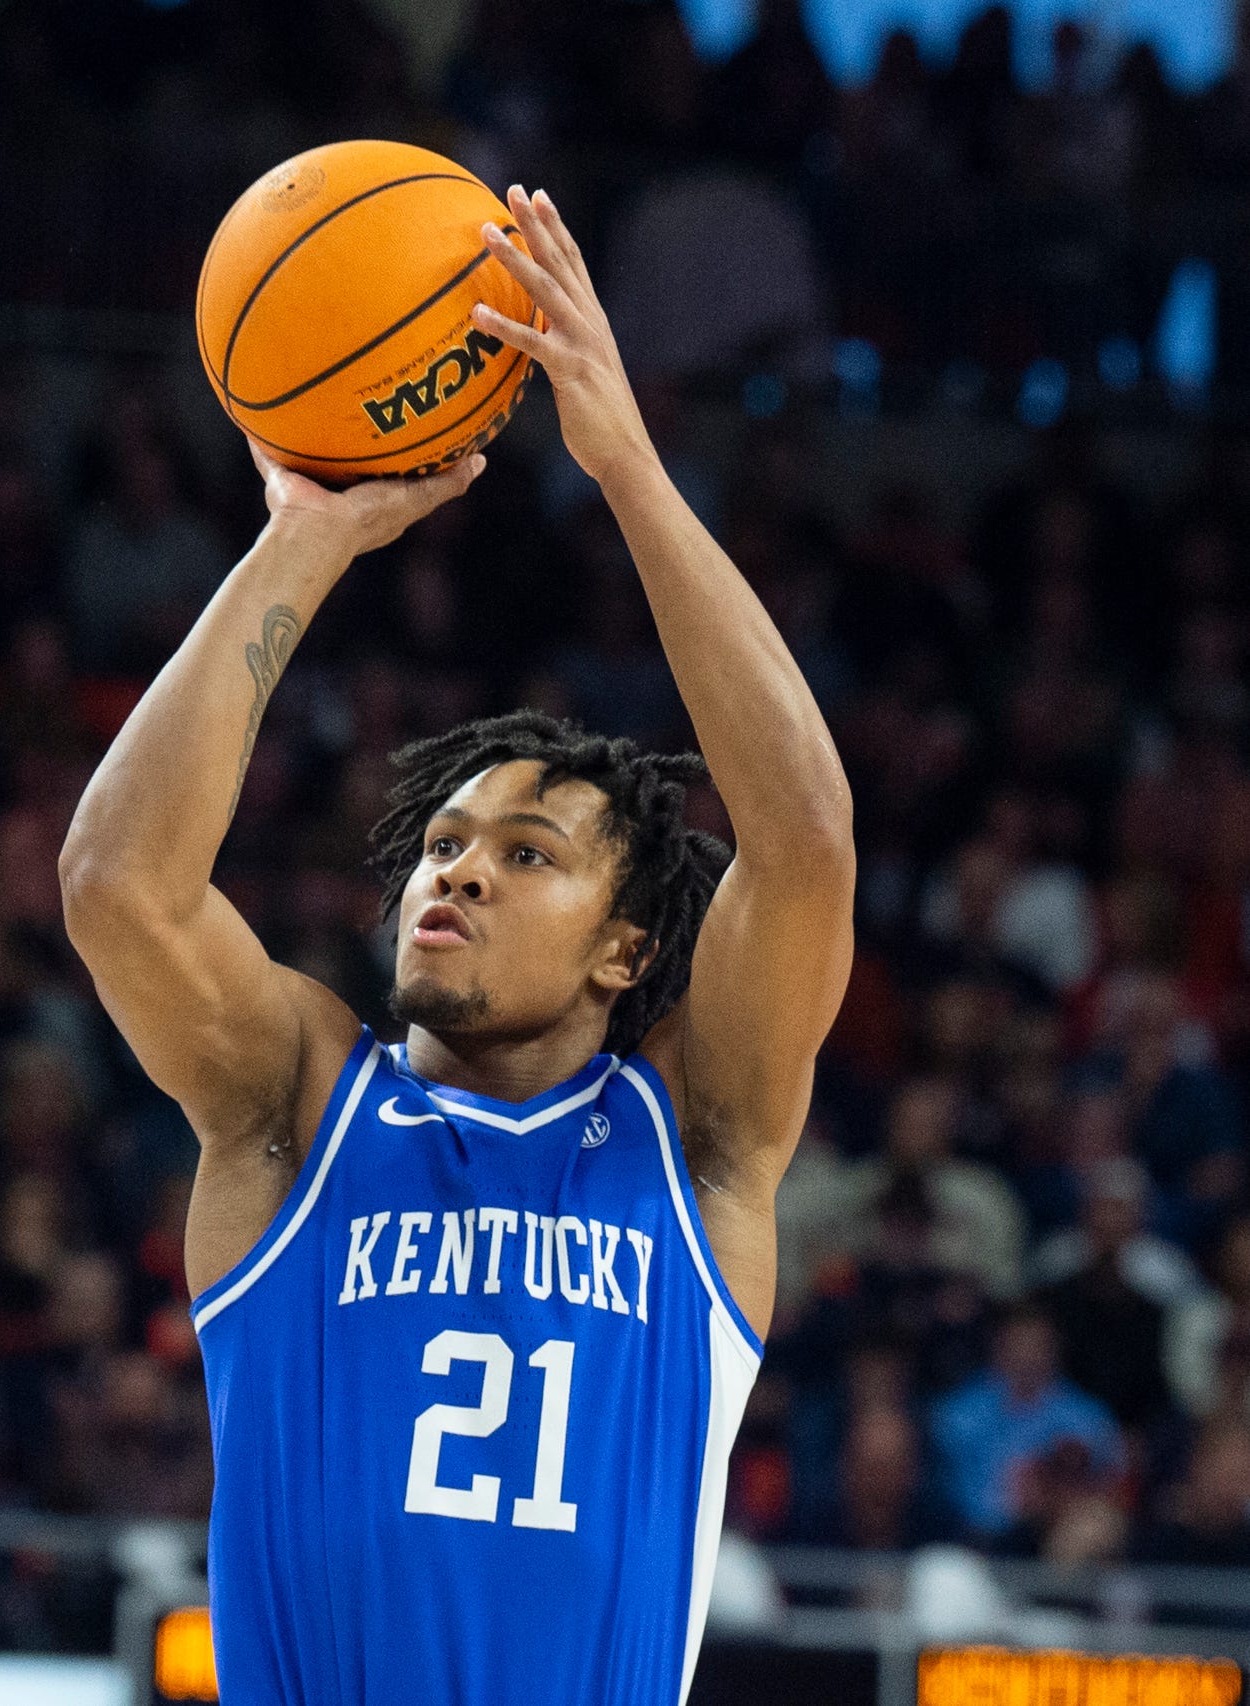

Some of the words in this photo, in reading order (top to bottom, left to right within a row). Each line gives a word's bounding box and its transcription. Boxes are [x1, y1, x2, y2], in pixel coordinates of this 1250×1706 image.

[353, 376, 393, 397] BALL
[361, 326, 505, 437] NCAA
[396, 347, 435, 378] GAME
[337, 1207, 653, 1325] KENTUCKY
[405, 1329, 578, 1533] 21
